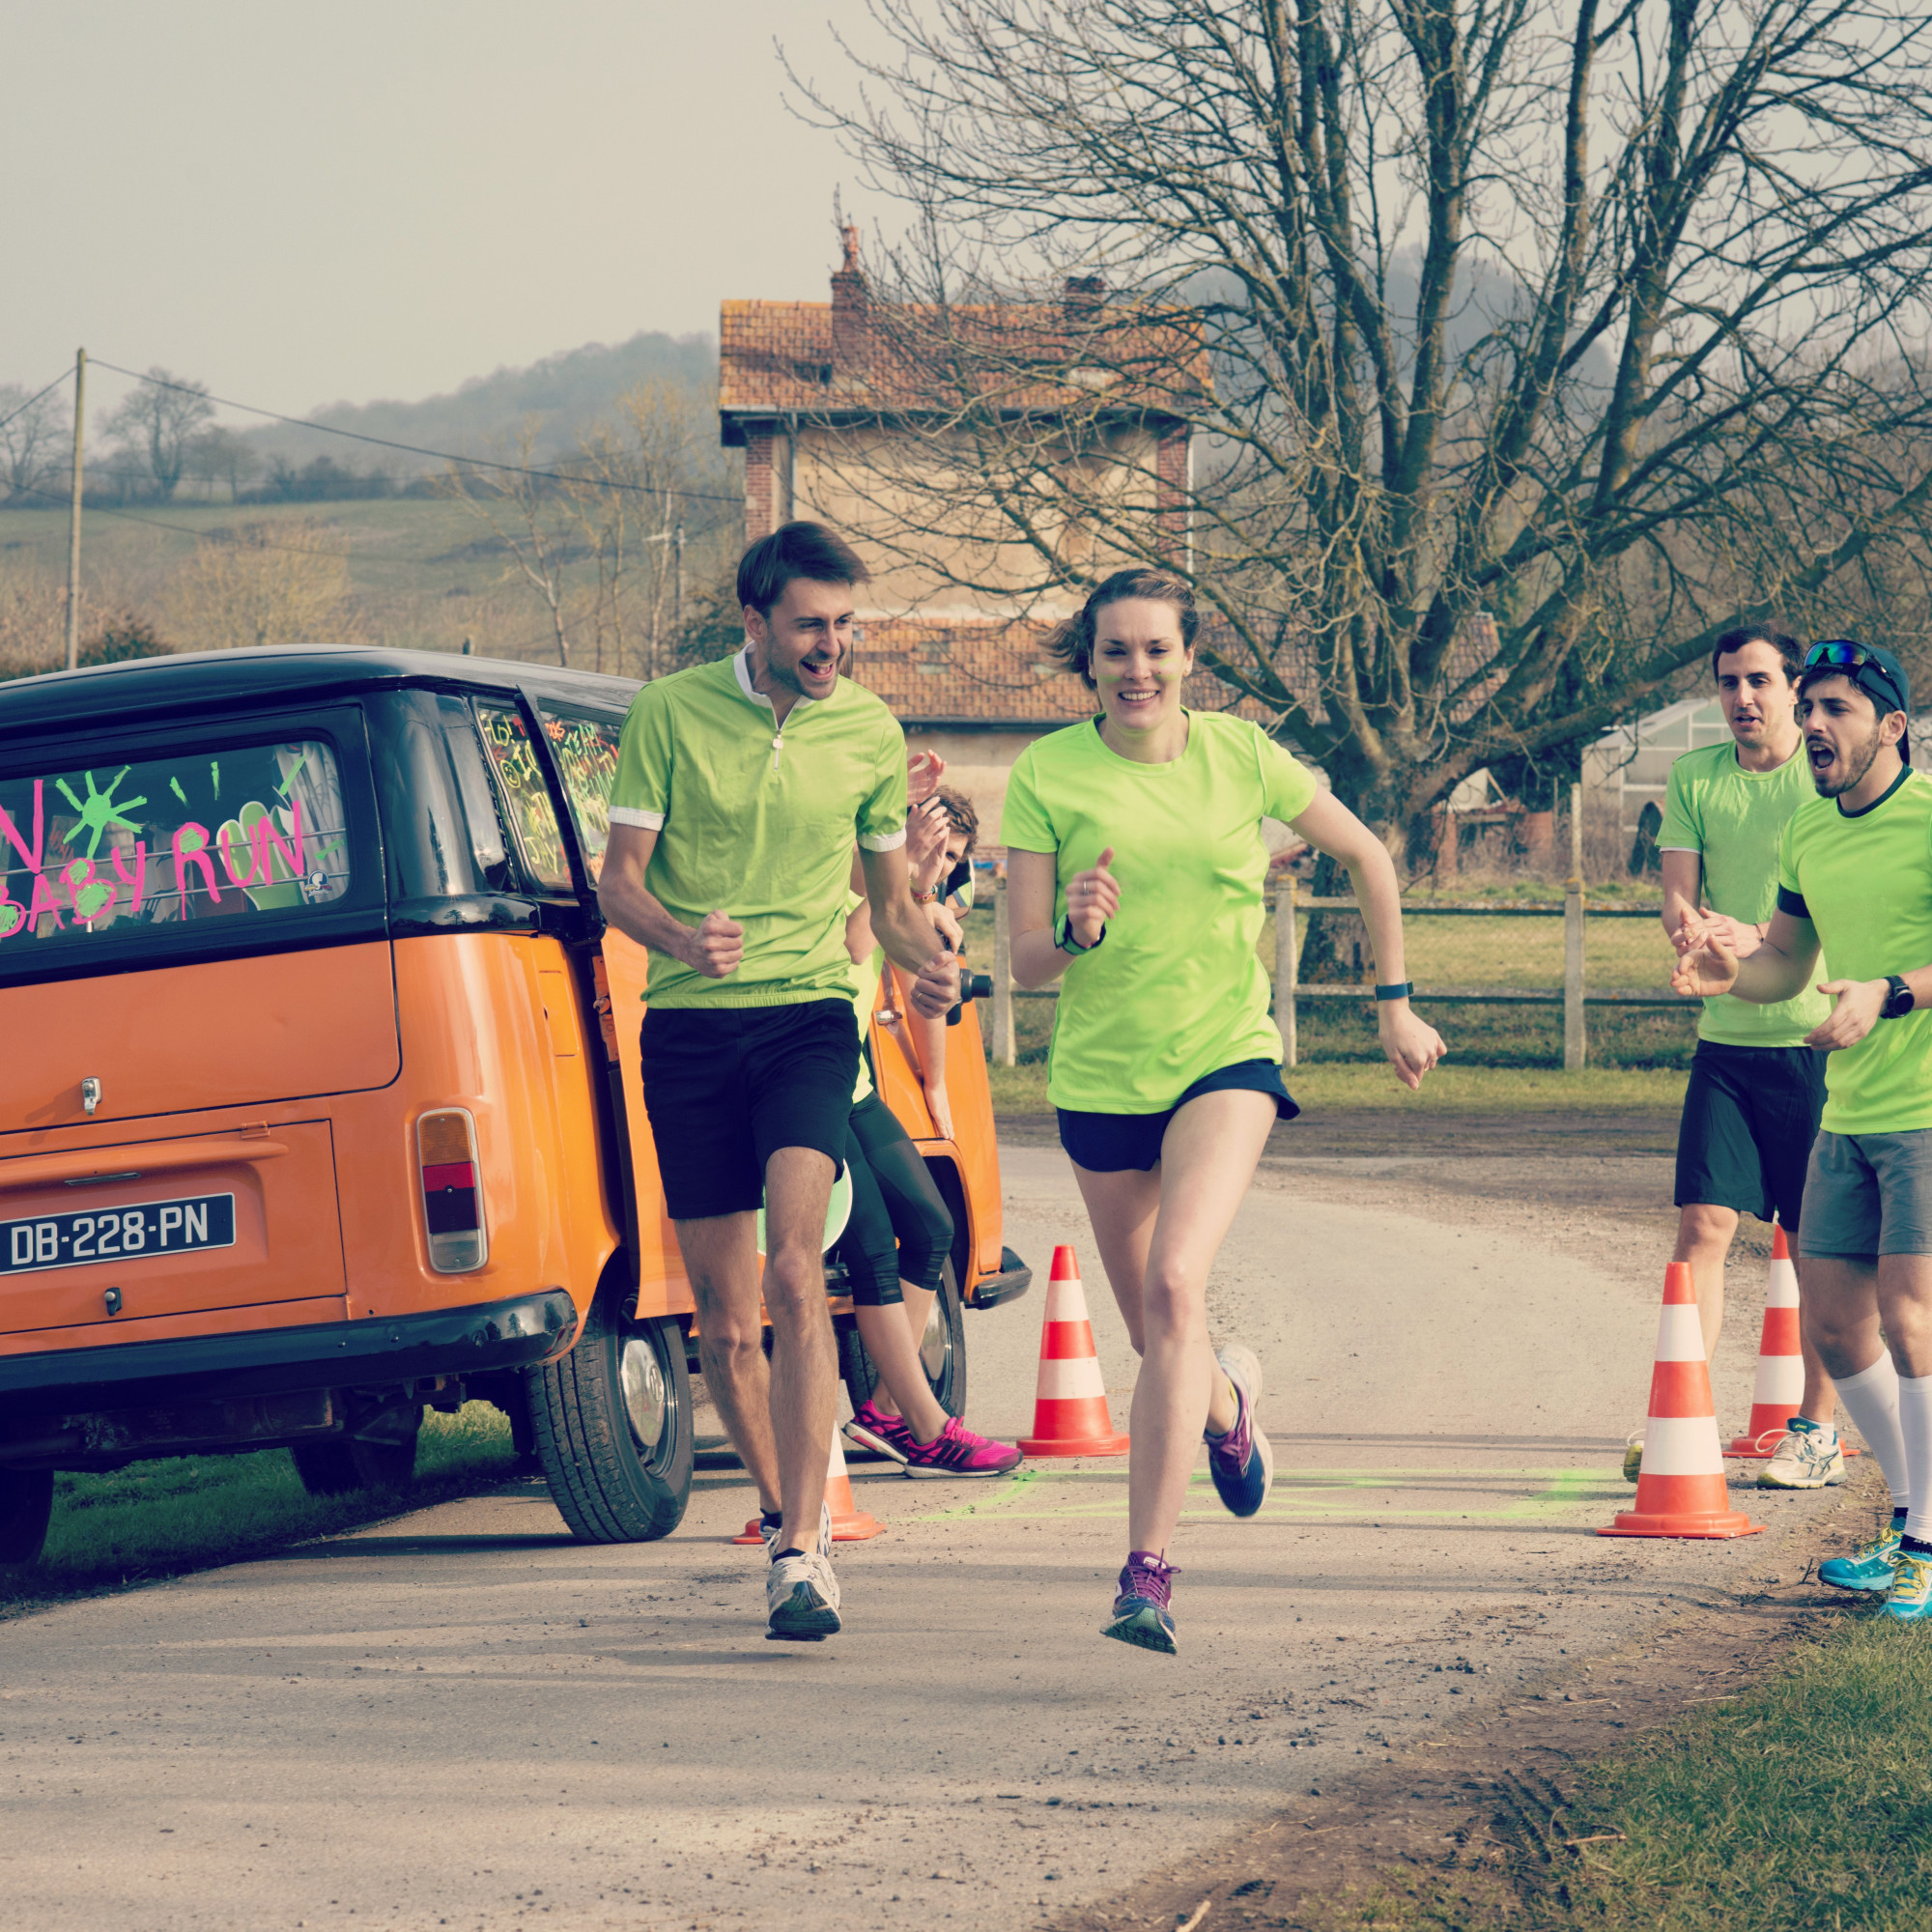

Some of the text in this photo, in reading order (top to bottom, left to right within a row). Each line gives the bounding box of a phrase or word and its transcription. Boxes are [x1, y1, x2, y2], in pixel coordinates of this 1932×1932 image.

[565, 723, 603, 755] TEAM
[0, 840, 145, 938] BABY
[173, 800, 303, 913] RUN
[12, 1203, 208, 1265] DB-228-PN
